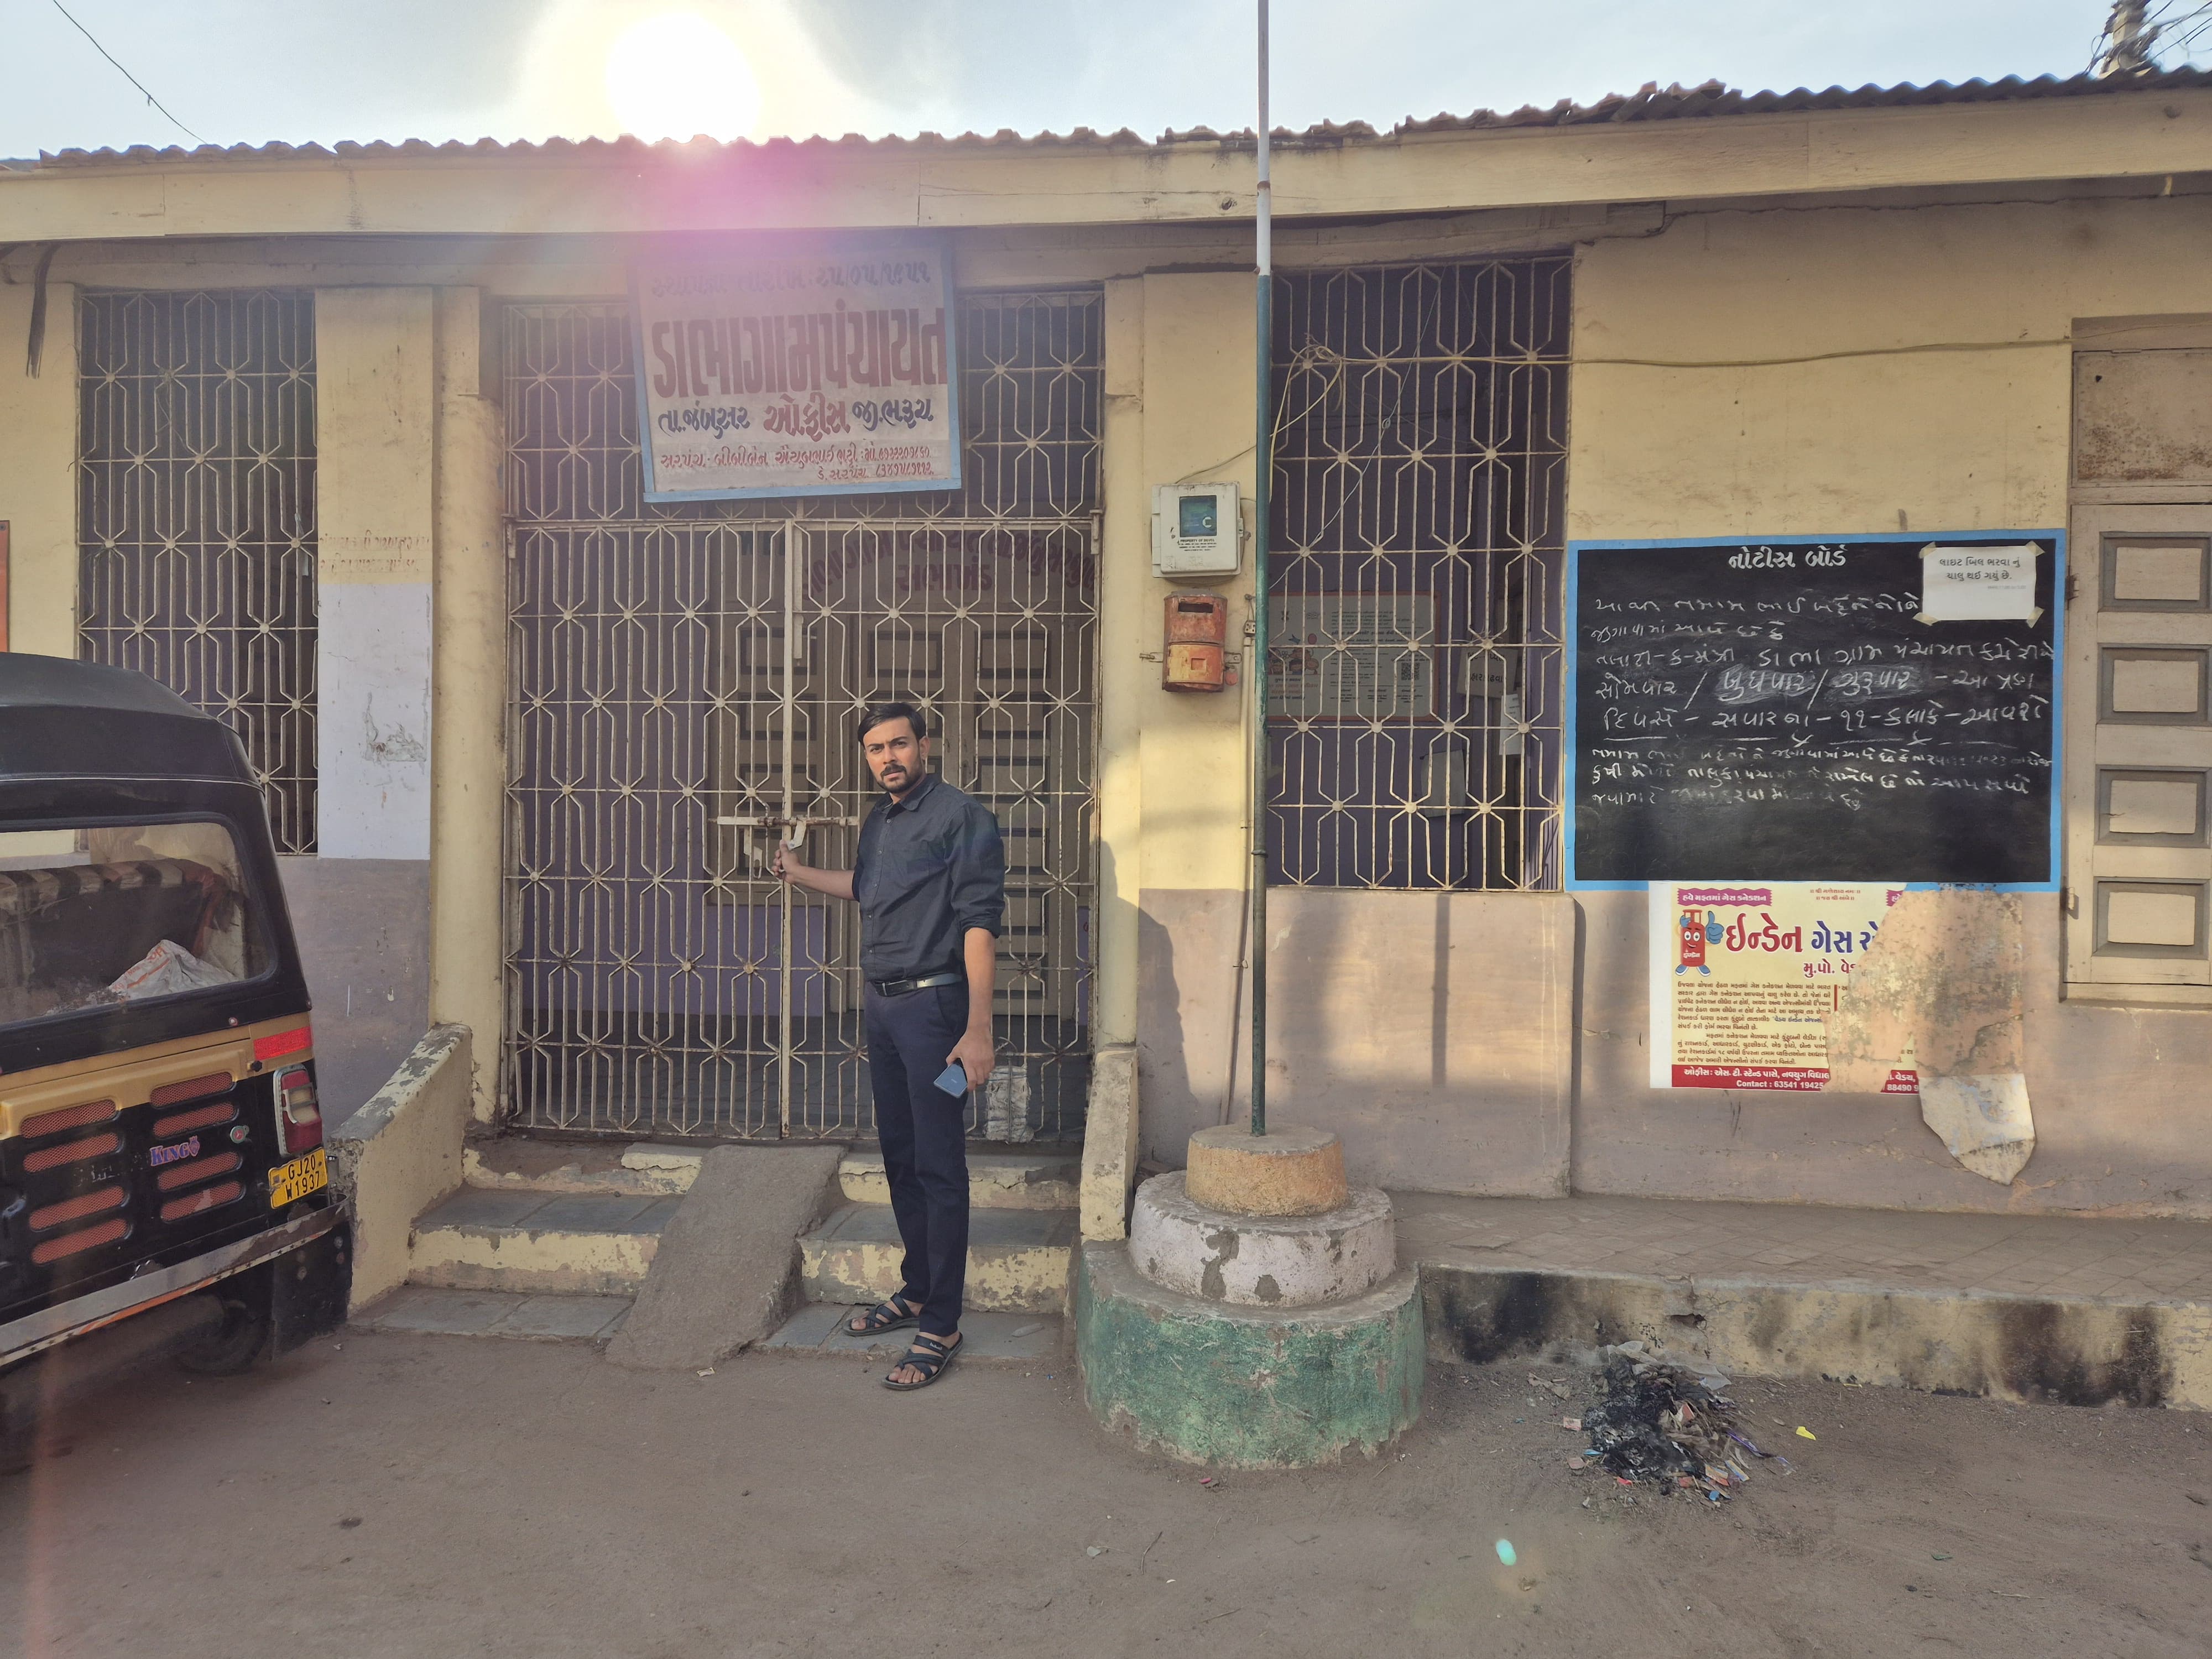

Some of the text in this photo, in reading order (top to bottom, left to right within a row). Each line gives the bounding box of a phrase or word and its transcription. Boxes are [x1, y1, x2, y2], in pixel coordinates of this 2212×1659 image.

[1728, 545, 1796, 569] નોટીસ
[1966, 556, 1984, 566] બિલ
[1726, 912, 1853, 953] ઈન્ડેન ગેસ
[150, 1141, 190, 1166] KING
[288, 1154, 316, 1180] GJ20
[285, 1170, 320, 1201] W1937
